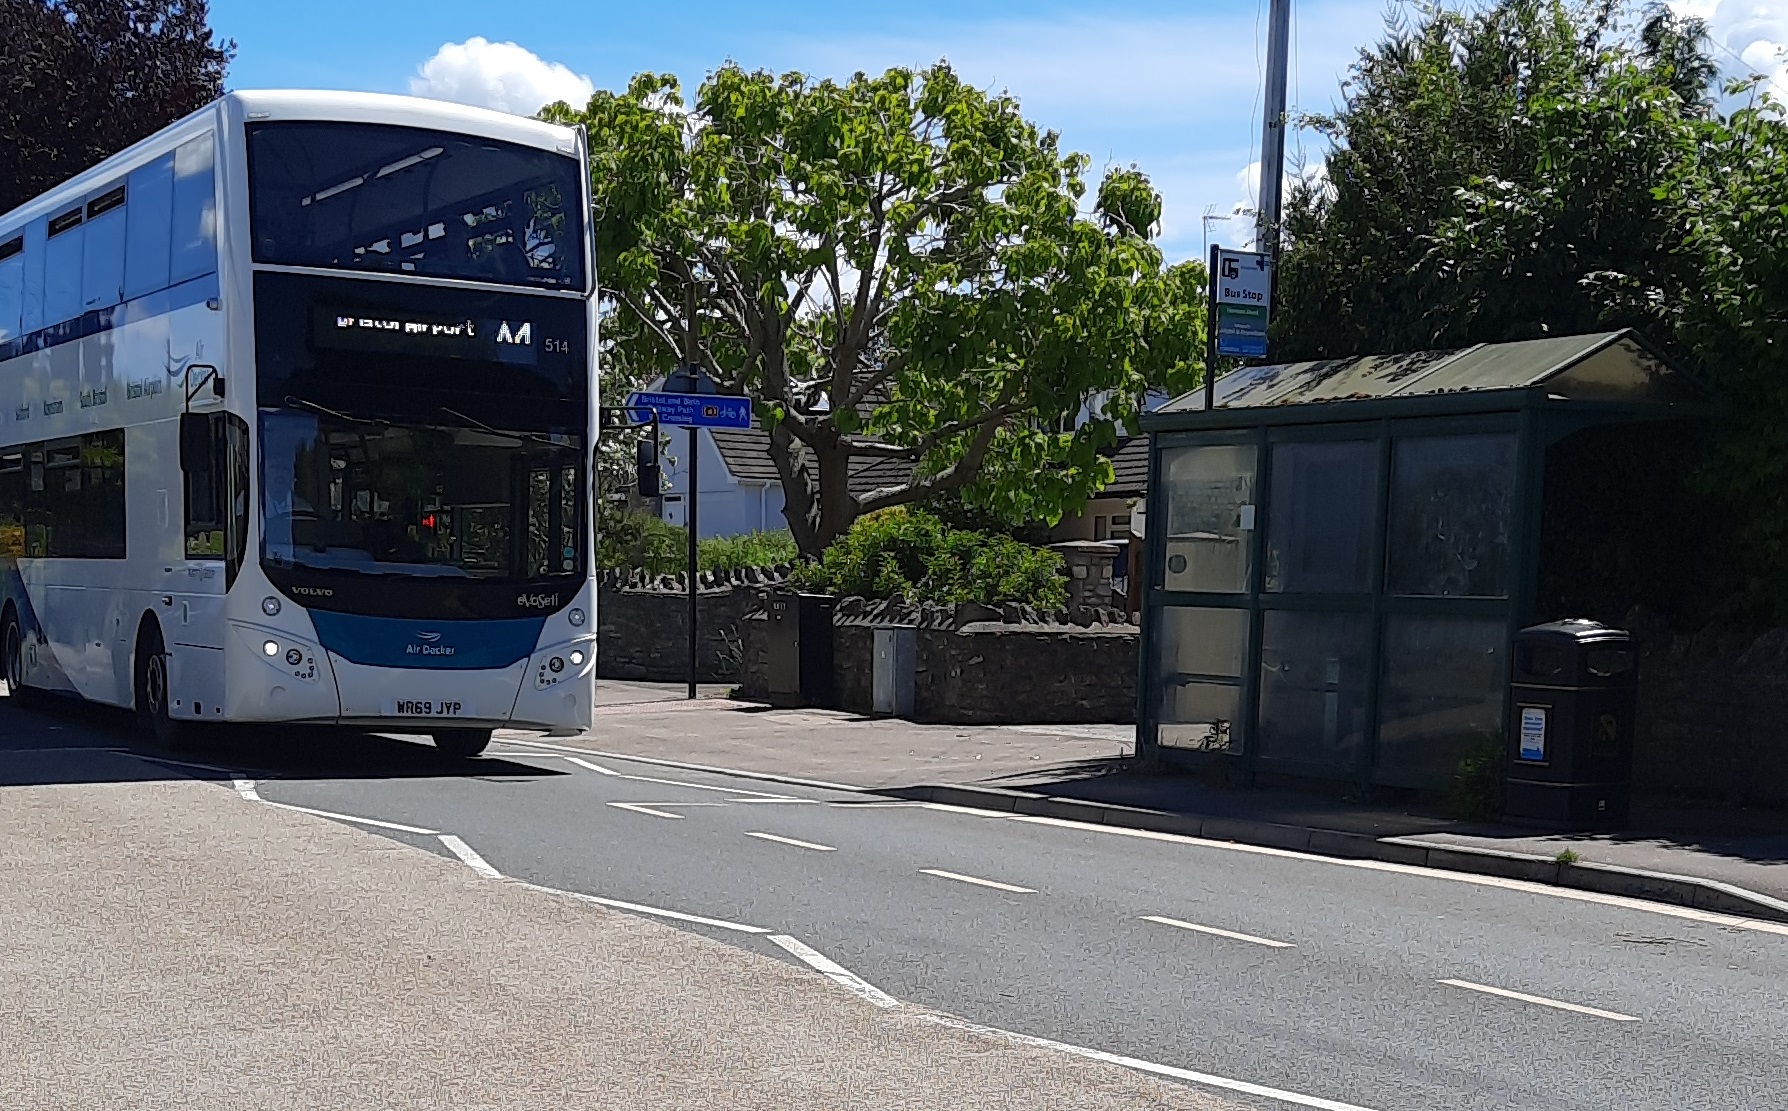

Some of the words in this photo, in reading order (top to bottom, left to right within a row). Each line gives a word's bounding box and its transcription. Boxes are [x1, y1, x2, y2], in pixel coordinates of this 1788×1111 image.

[1224, 287, 1241, 298] Bus
[1242, 288, 1263, 302] Stop
[545, 338, 570, 355] 514
[291, 586, 334, 597] VOLVO
[405, 643, 421, 654] Air
[422, 644, 455, 656] Decker
[396, 700, 432, 716] WR69
[435, 701, 462, 716] JYP
